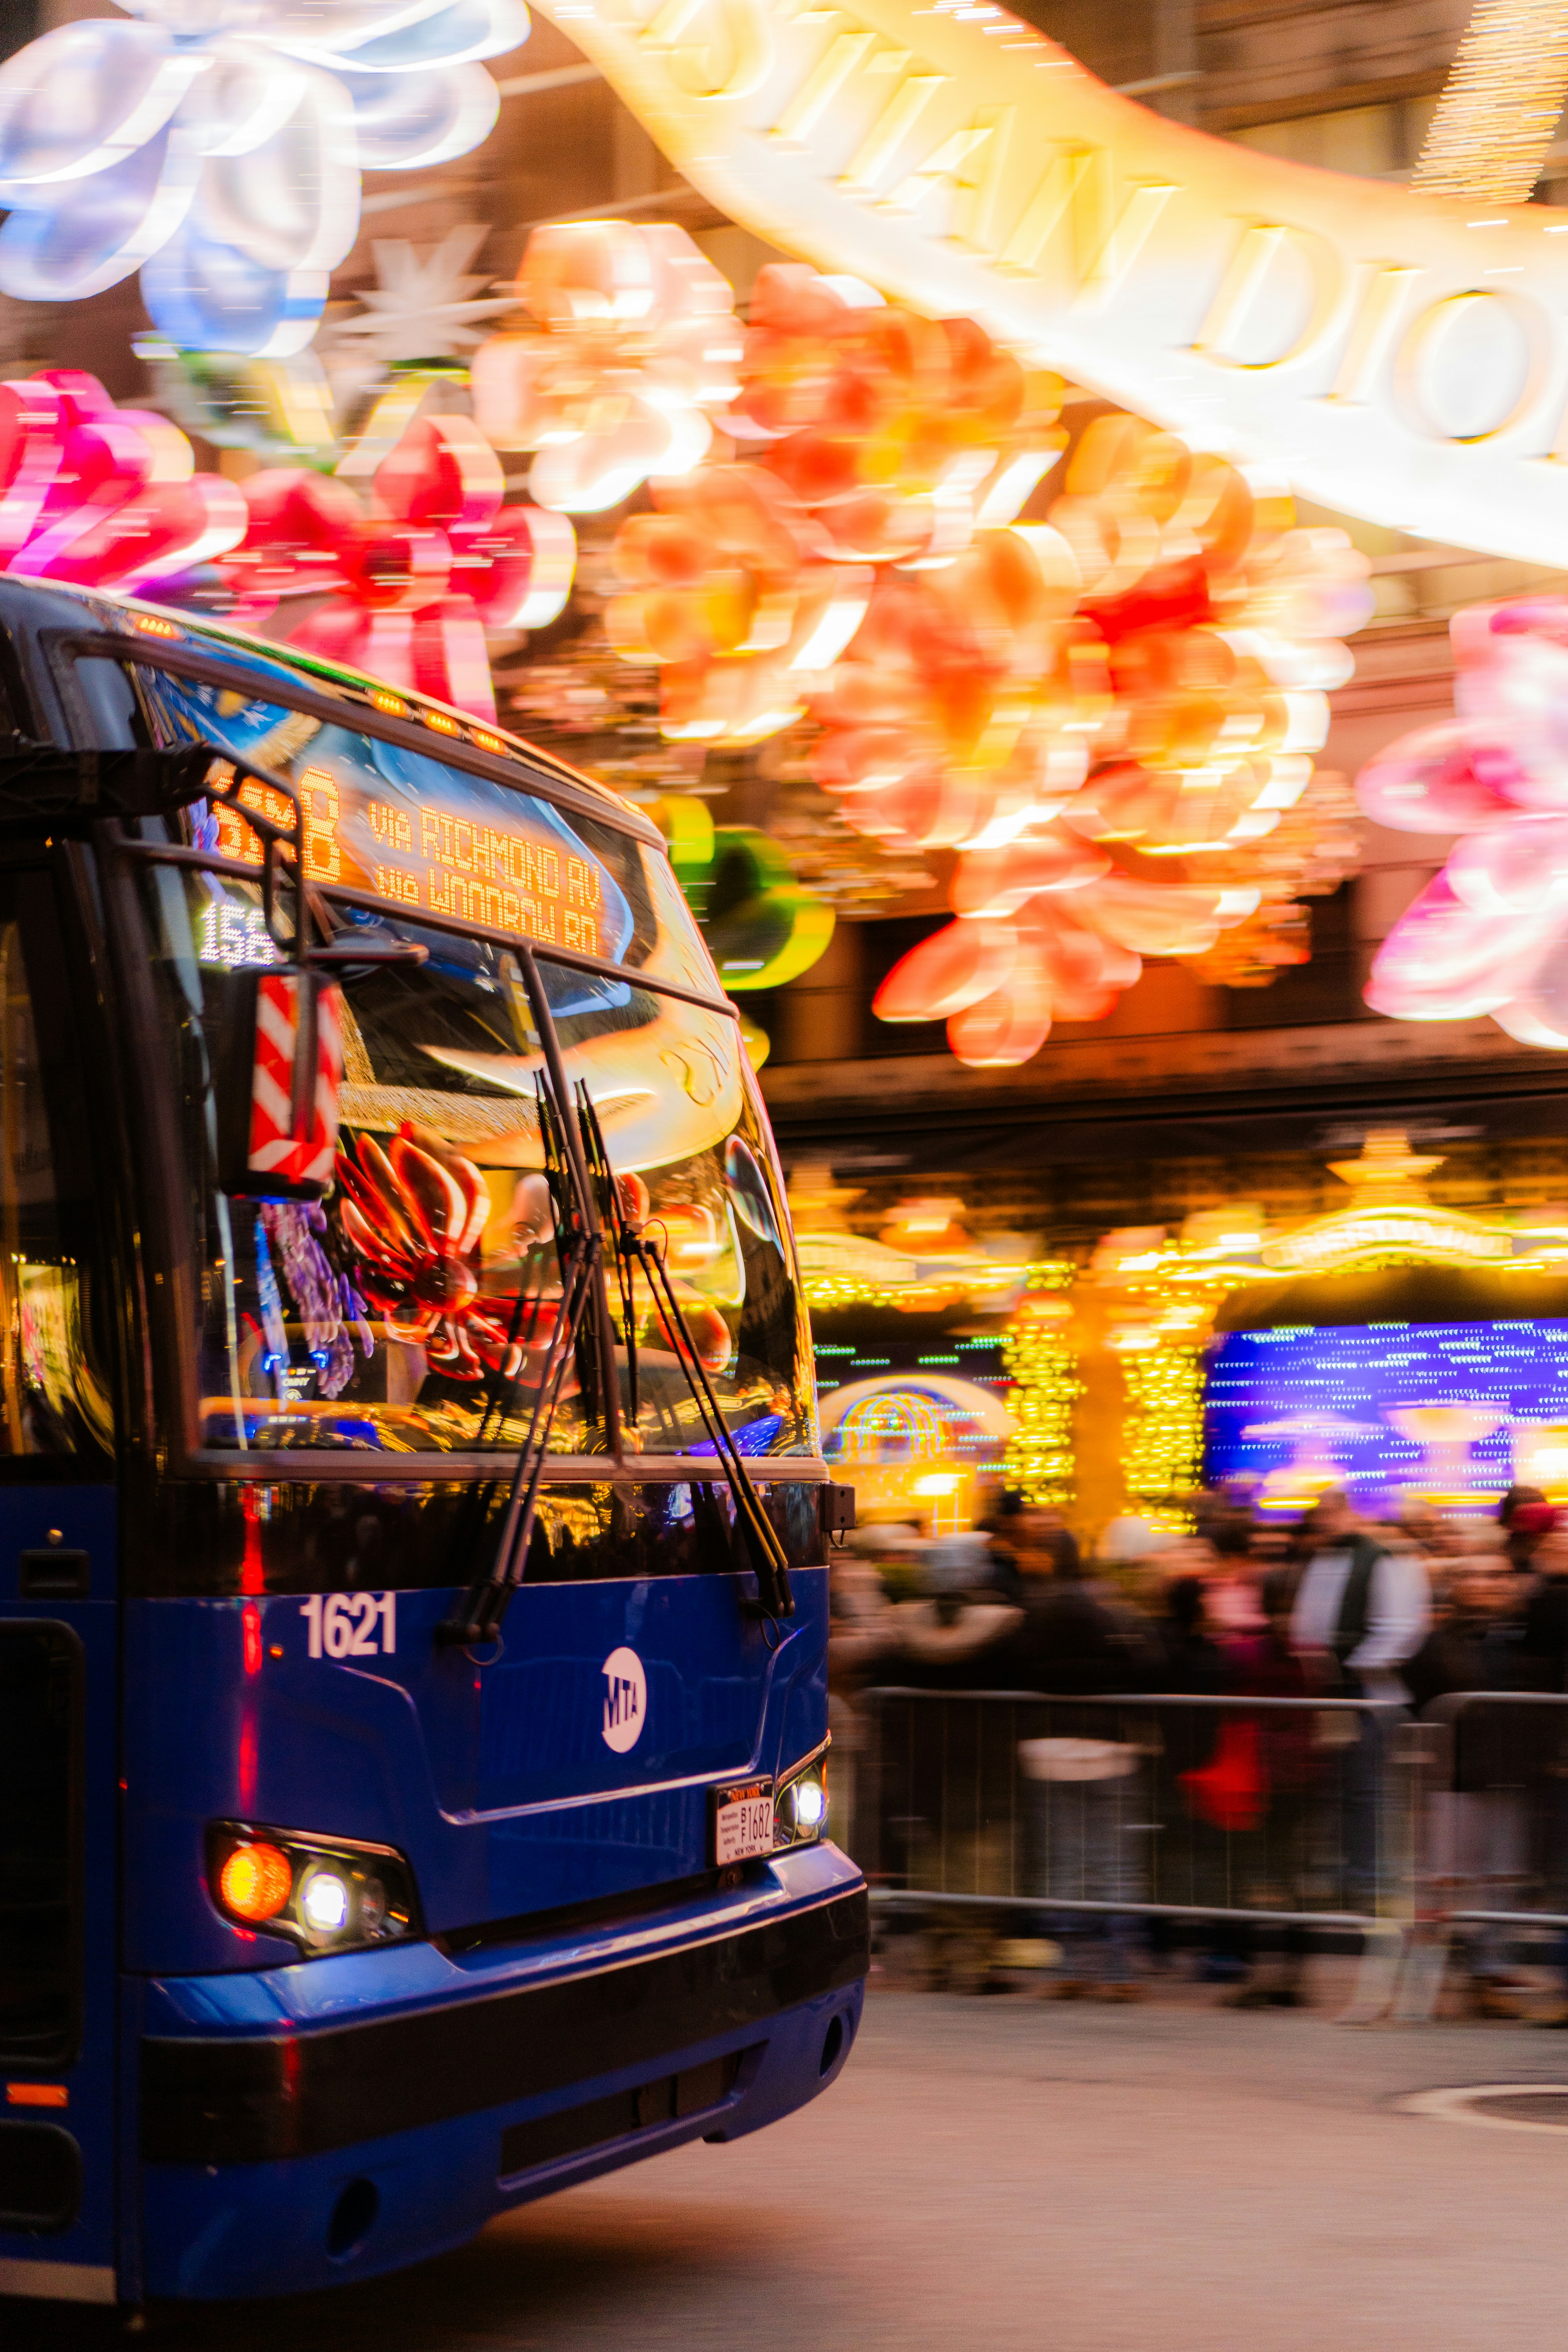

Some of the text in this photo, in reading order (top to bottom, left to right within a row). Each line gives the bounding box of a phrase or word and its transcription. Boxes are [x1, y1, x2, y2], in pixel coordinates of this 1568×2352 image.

[421, 804, 560, 899] RICHMOND
[568, 855, 601, 911] AV
[200, 900, 274, 966] 156
[564, 908, 597, 957] RD
[282, 1377, 310, 1387] OMNY
[300, 1591, 396, 1659] 1621
[735, 1844, 756, 1856] NEW YORK
